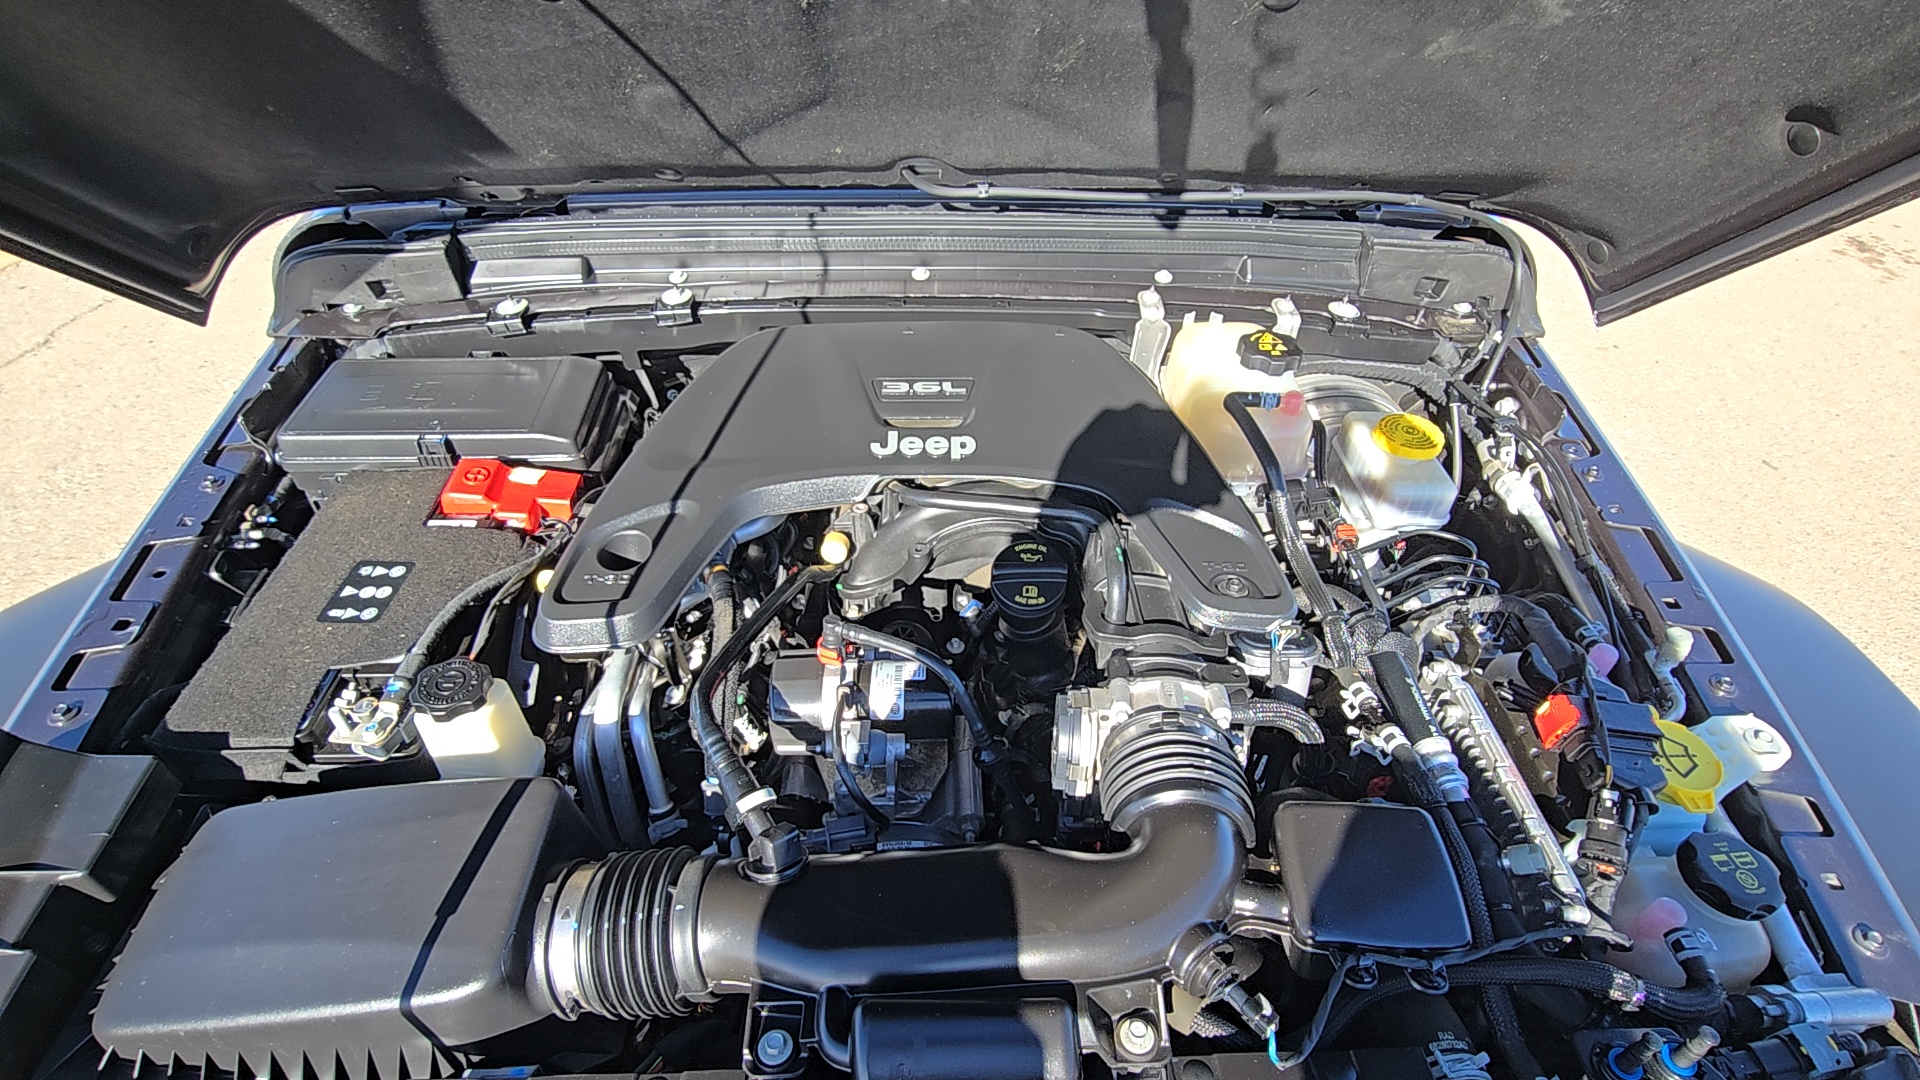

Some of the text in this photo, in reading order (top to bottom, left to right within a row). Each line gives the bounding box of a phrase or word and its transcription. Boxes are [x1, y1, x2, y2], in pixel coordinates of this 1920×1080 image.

[881, 381, 967, 396] 3.6L
[870, 431, 977, 461] Jeep
[1014, 543, 1048, 554] ENGINE OIL
